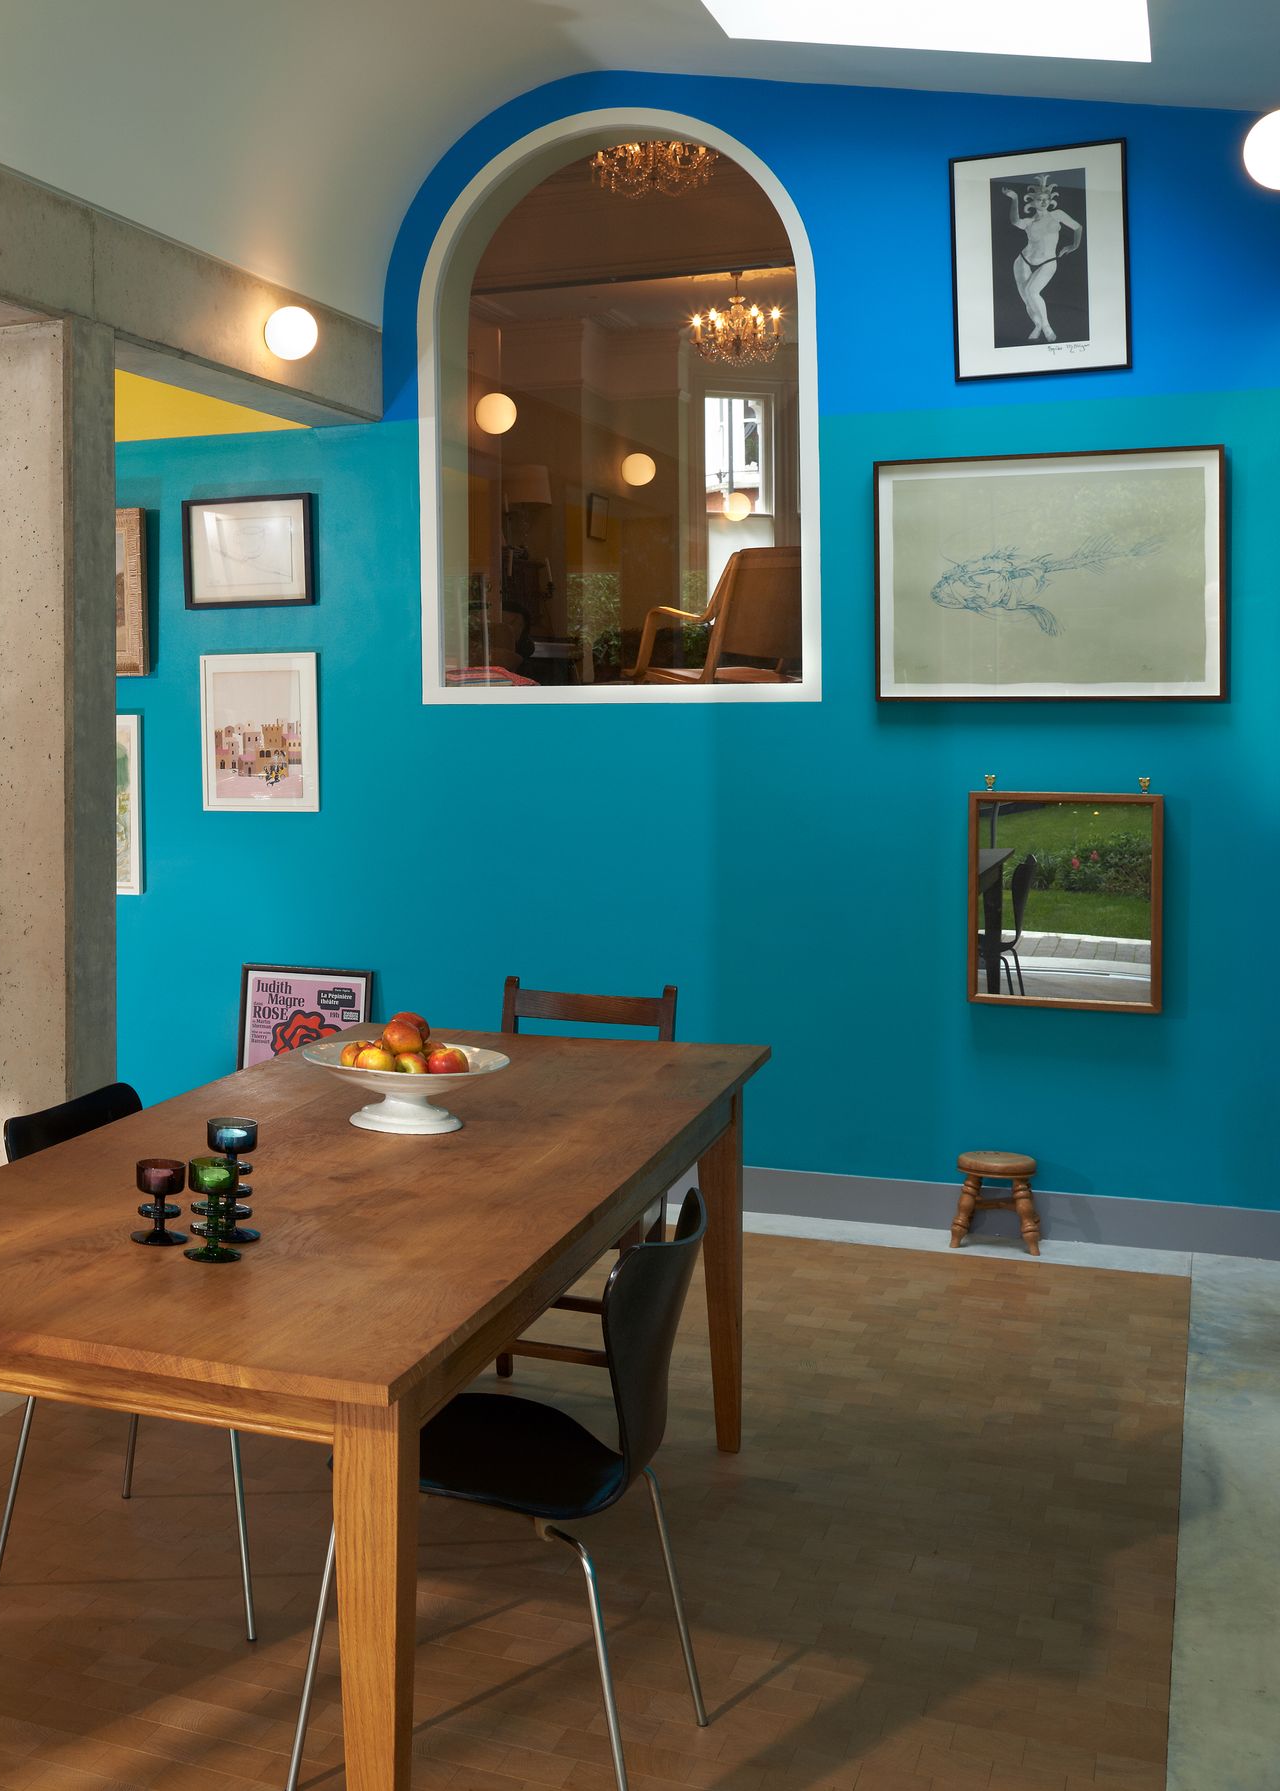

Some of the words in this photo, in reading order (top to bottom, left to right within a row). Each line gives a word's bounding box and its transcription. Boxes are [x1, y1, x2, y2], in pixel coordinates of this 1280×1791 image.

[256, 980, 291, 994] Judith
[268, 994, 304, 1008] Magre
[253, 1006, 288, 1020] ROSE
